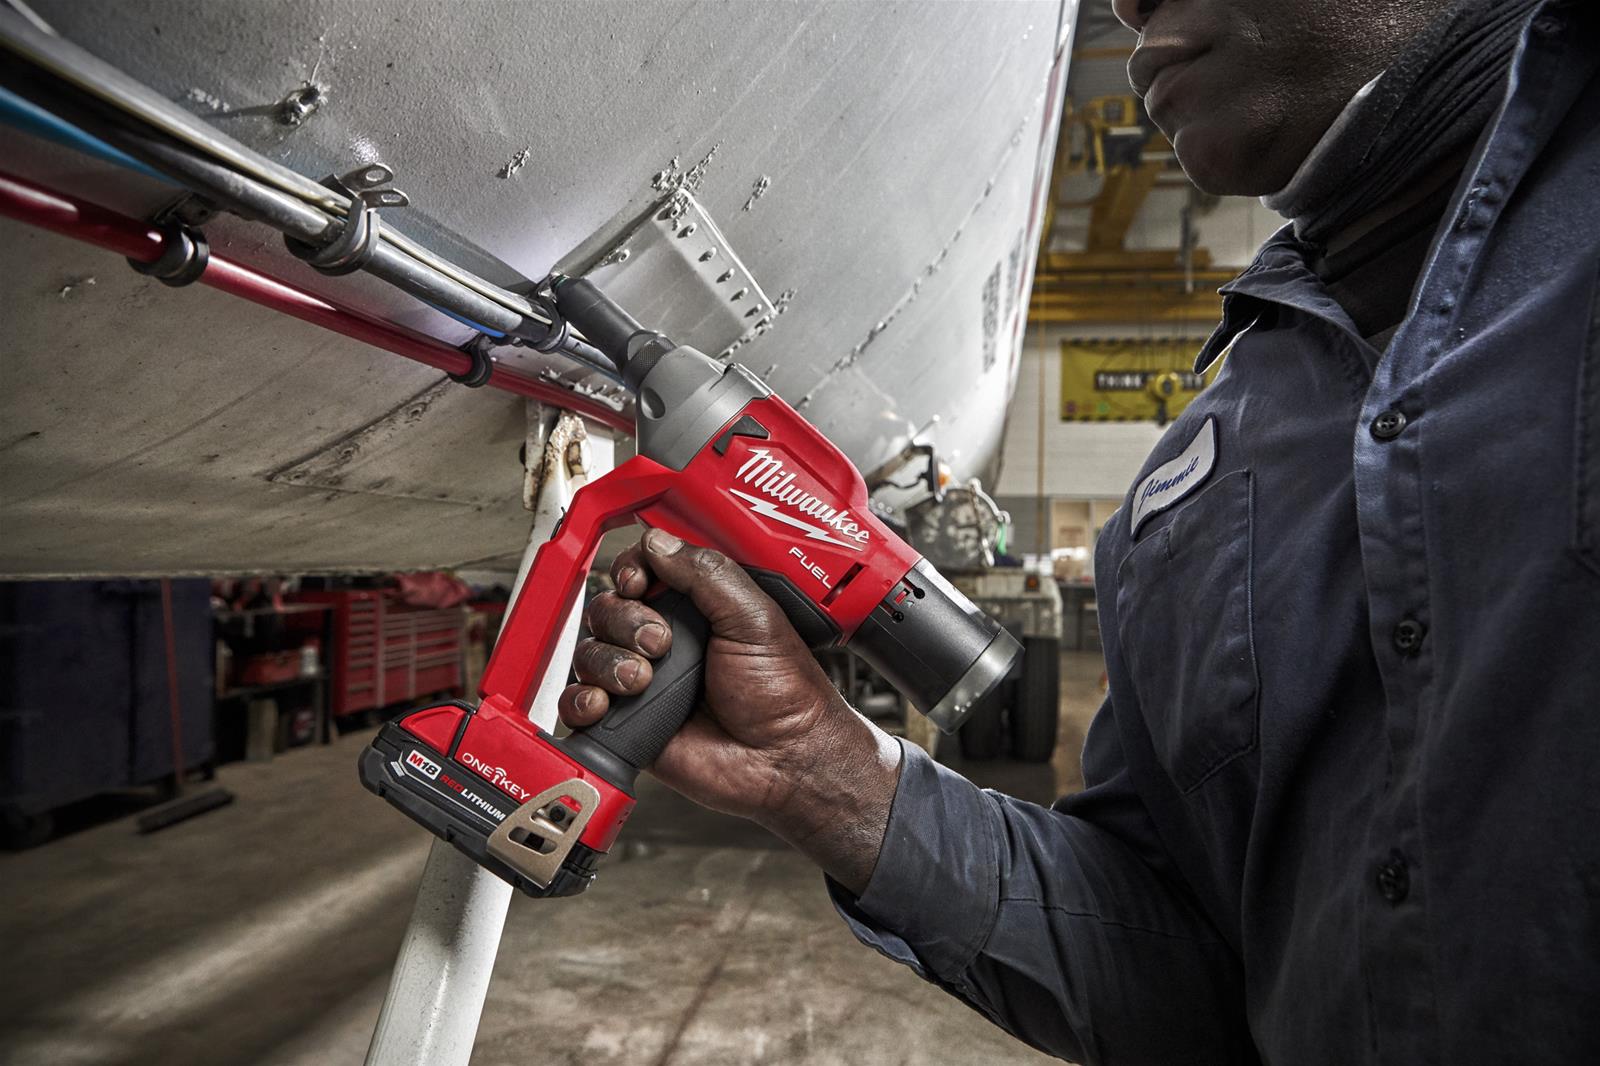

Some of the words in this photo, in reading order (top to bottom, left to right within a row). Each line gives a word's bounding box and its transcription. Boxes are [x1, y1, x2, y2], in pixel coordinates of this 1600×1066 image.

[735, 448, 870, 544] Milwaukee
[788, 547, 832, 589] FUEL
[407, 753, 440, 777] M18
